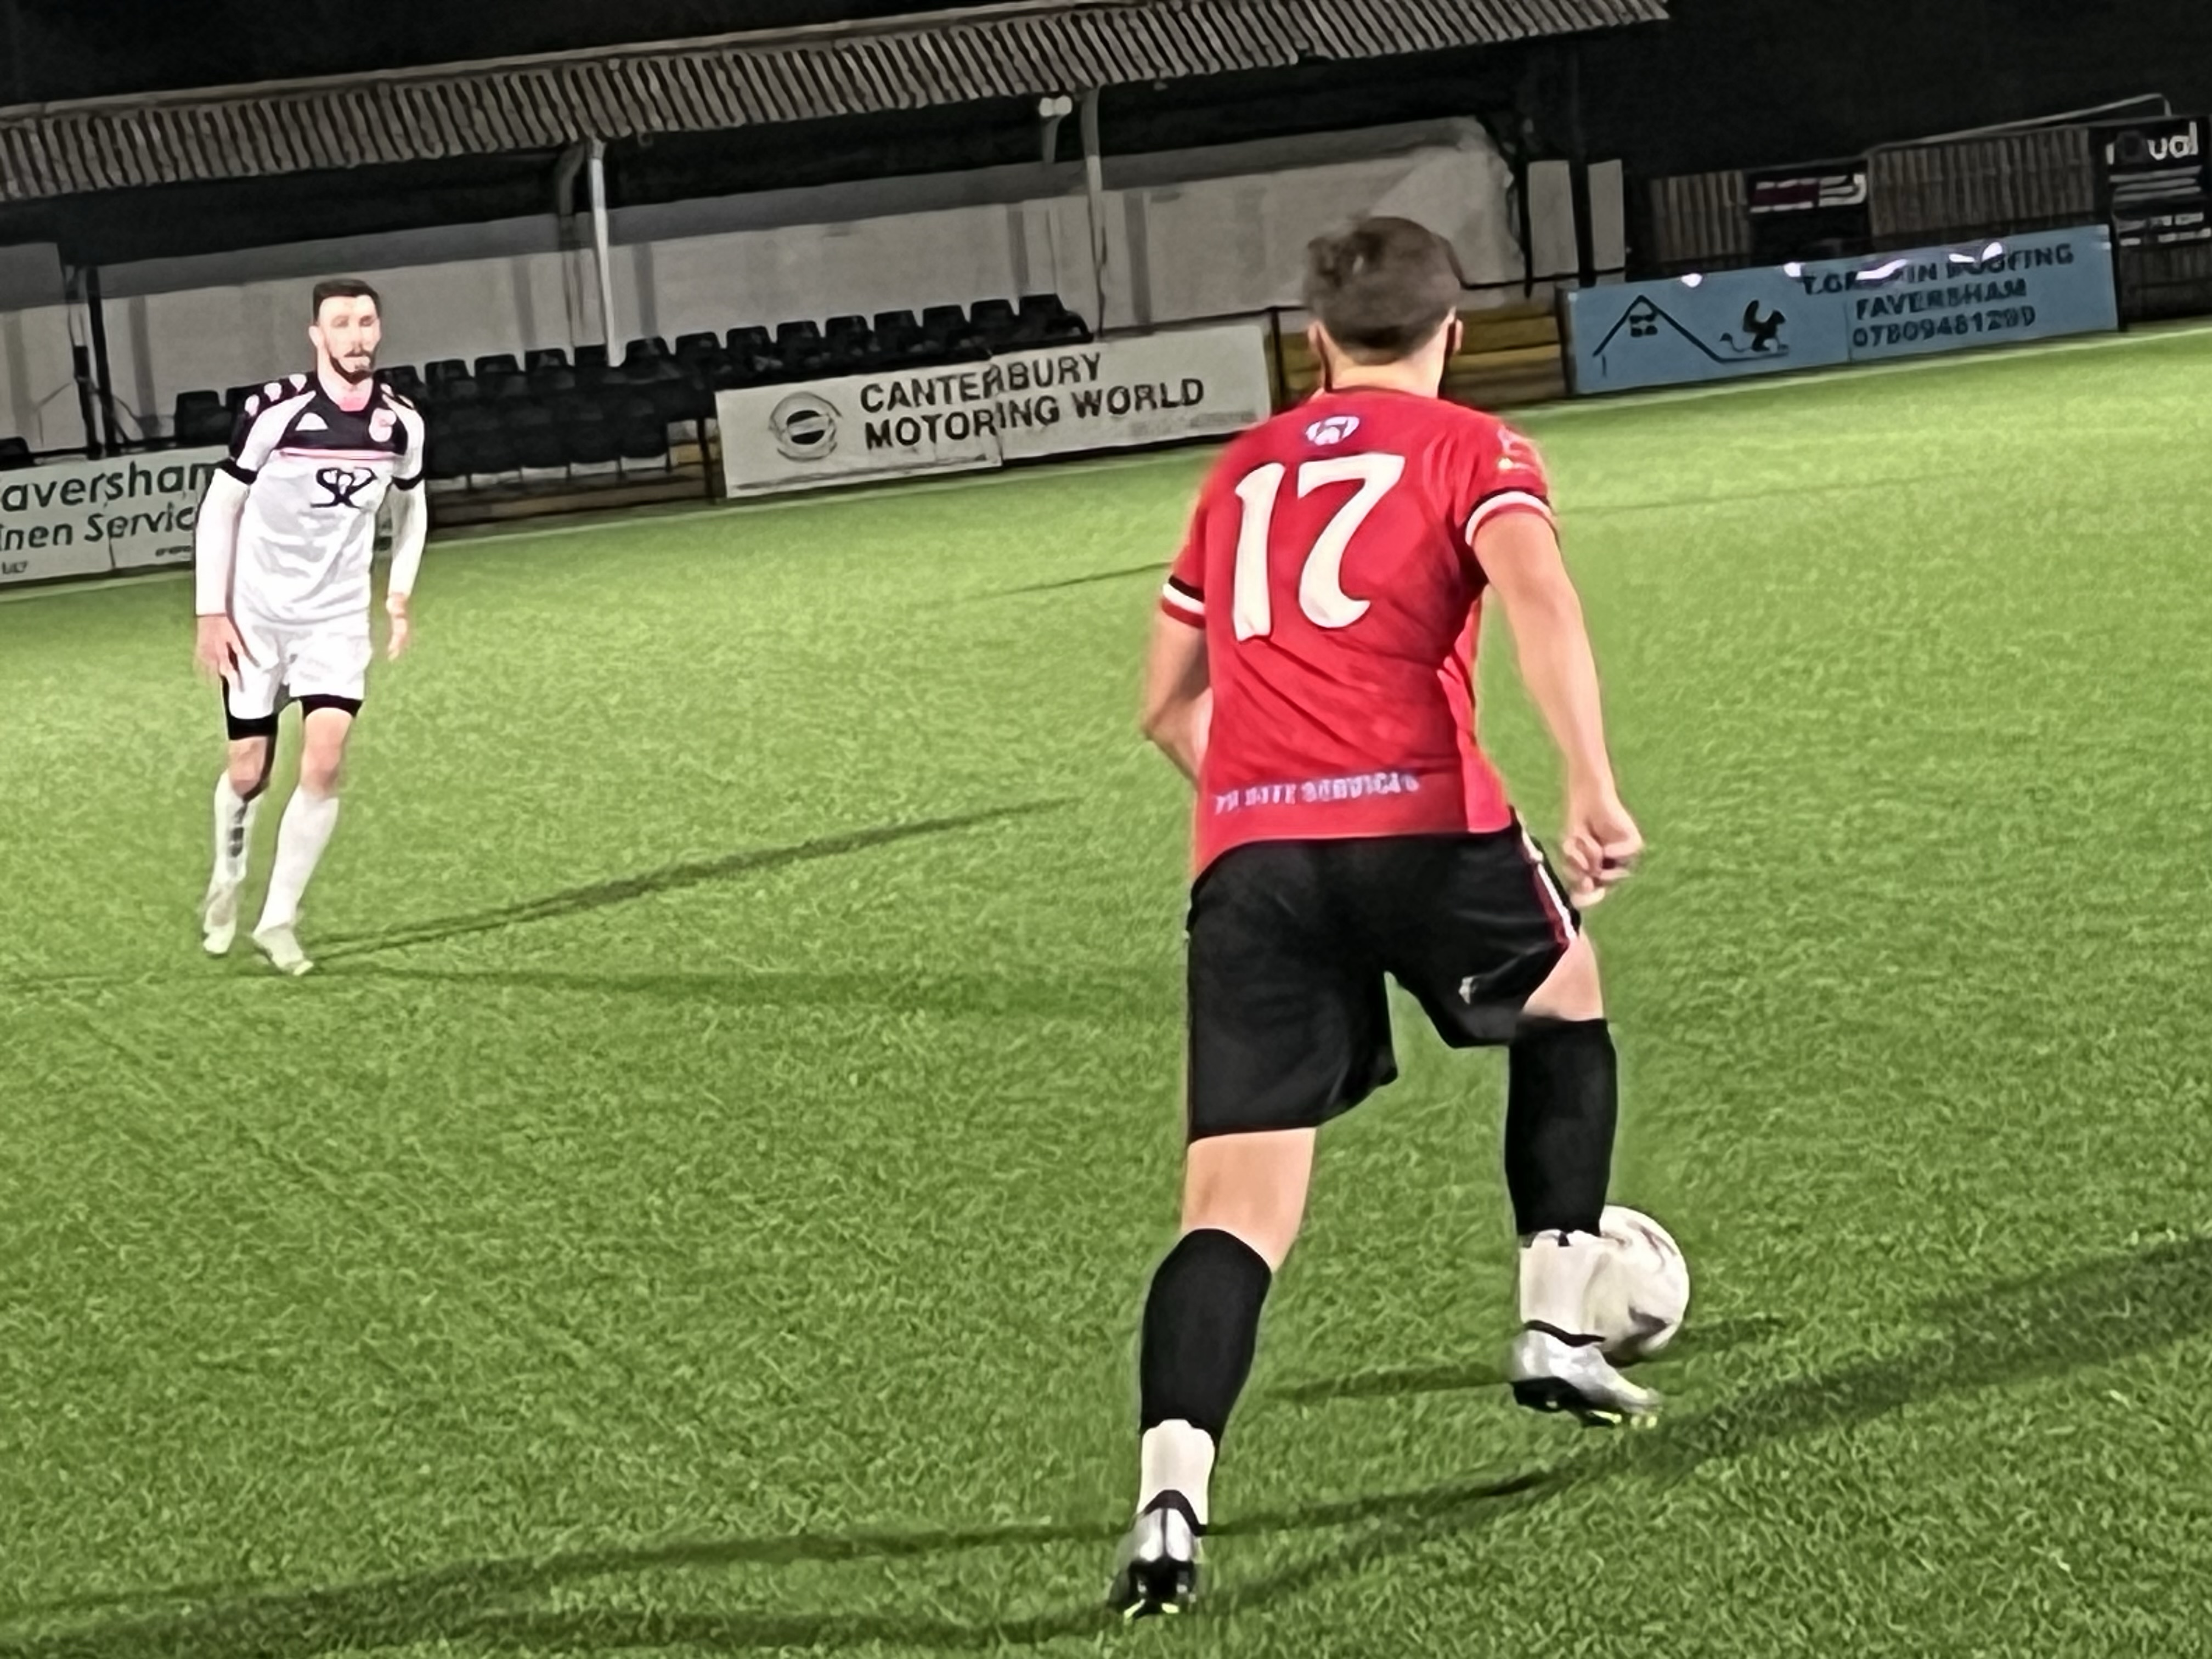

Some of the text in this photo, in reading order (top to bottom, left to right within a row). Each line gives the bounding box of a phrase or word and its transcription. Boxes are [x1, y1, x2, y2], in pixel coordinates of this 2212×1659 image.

[1857, 278, 2027, 320] FAVERSHAM
[860, 353, 1101, 413] CANTERBURY
[865, 378, 1205, 450] MOTORING WORLD
[83, 501, 194, 542] Servic
[1233, 452, 1406, 642] 17
